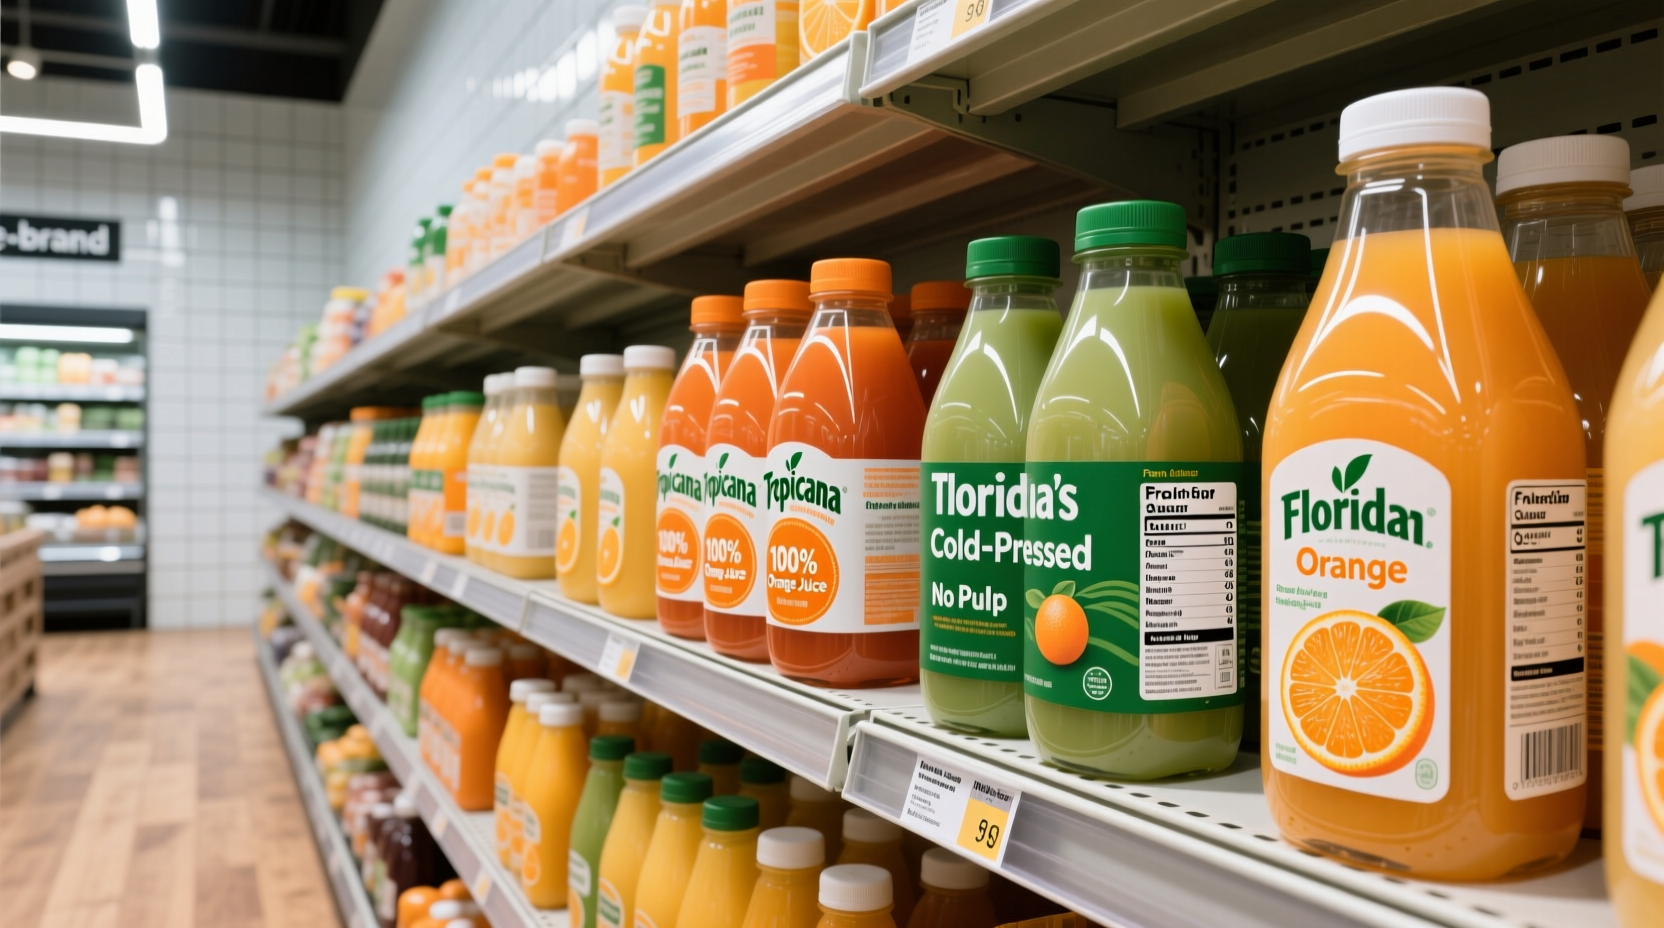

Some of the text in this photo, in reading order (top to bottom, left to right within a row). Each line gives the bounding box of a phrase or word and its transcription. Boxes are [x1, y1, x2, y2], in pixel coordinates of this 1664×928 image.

[1281, 487, 1424, 547] Floridan
[706, 538, 742, 564] 100%
[770, 545, 818, 575] 100%
[931, 528, 1092, 571] Cold-Pressed
[1296, 546, 1408, 590] Orange
[932, 581, 1008, 617] No Pulp
